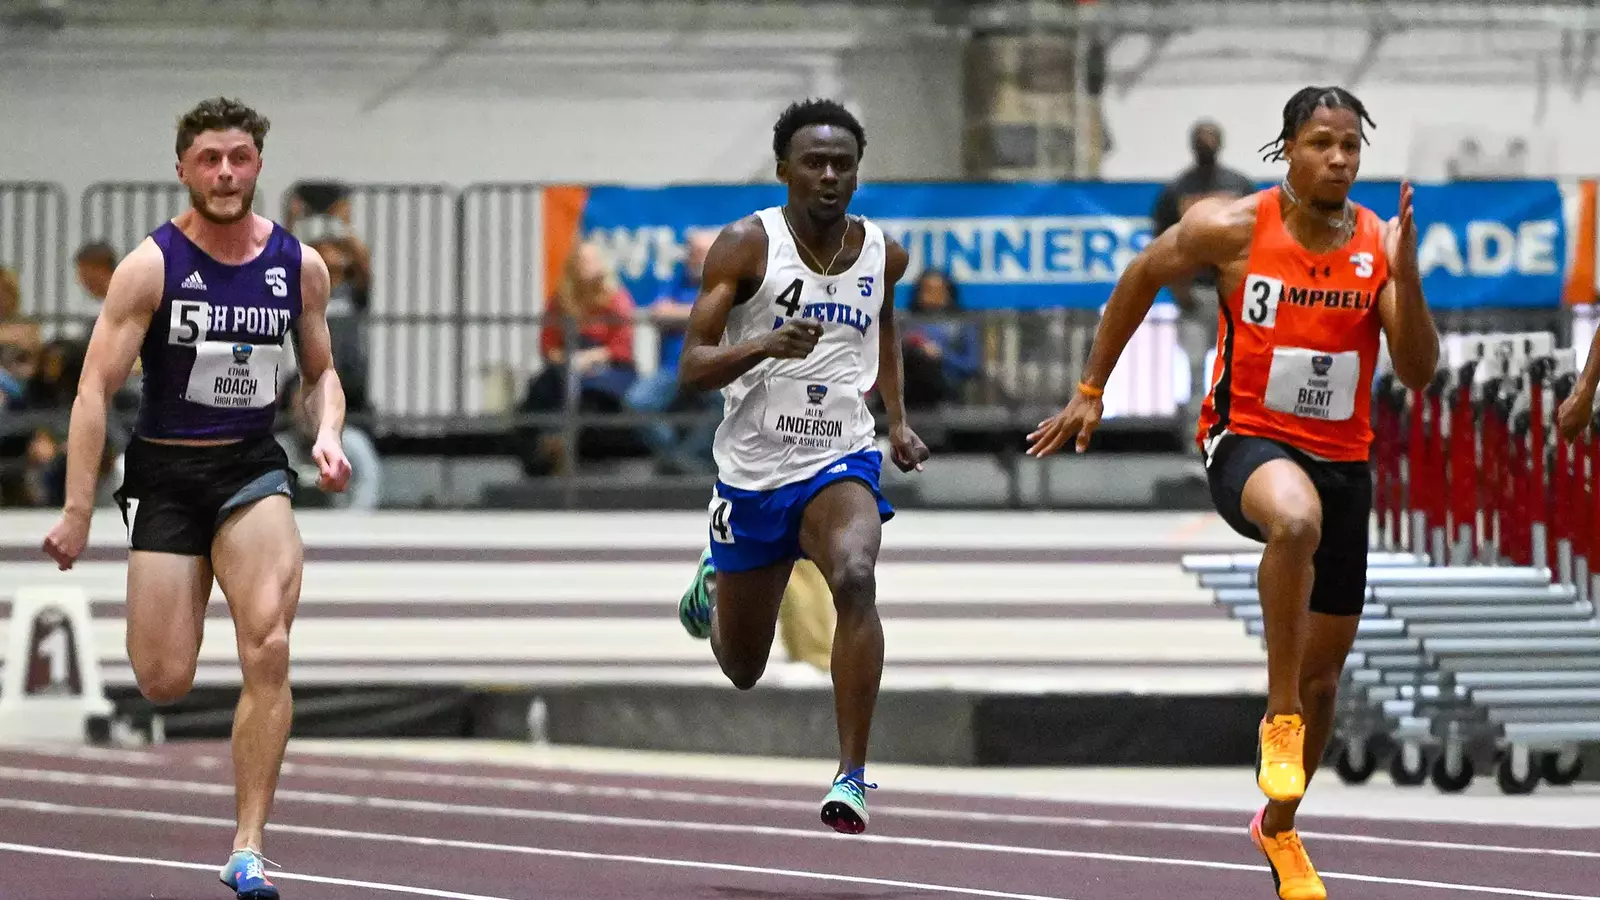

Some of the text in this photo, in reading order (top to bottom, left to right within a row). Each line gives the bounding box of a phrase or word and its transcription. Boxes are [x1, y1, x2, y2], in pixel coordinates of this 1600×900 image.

[1417, 220, 1560, 277] ADE
[775, 278, 804, 318] 4
[1248, 280, 1271, 323] 3
[1279, 284, 1371, 310] AMPBELL
[177, 304, 201, 345] 5
[206, 304, 291, 337] GH POINT
[227, 367, 250, 377] ETHAN
[214, 376, 258, 396] ROACH
[1297, 387, 1334, 406] BENT
[214, 395, 252, 407] HIGH POINT
[805, 407, 824, 418] JALEN
[775, 414, 843, 438] ANDERSON
[782, 434, 833, 449] UNC ASHEVILLE
[712, 501, 728, 541] 4
[38, 625, 67, 682] 1
